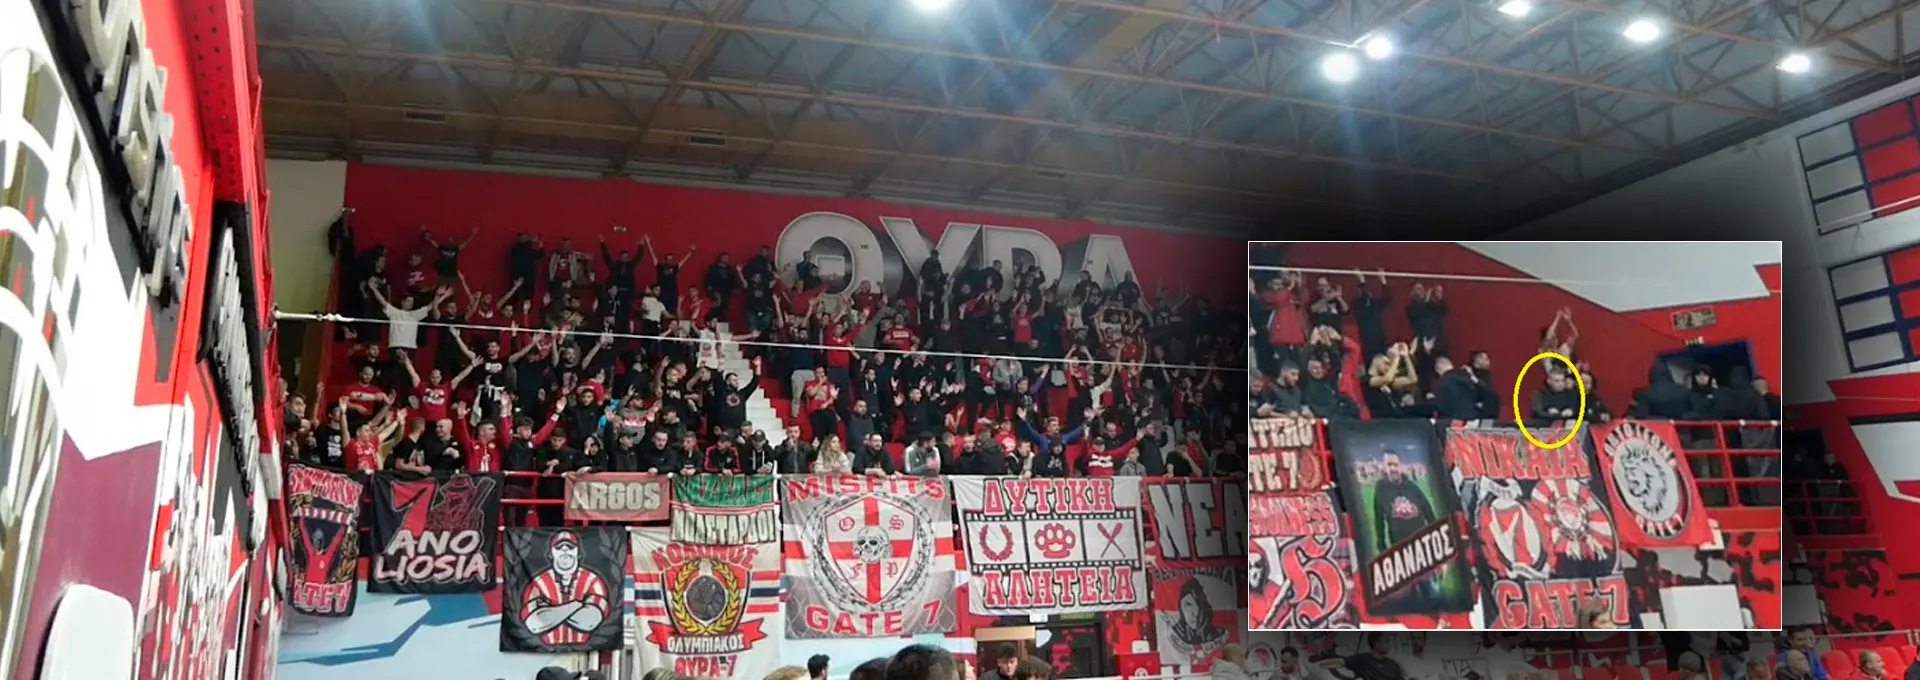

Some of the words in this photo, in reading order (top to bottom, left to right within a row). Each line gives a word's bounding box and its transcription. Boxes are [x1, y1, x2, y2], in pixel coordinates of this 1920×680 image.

[570, 480, 661, 511] ARGOS
[788, 473, 945, 500] MISFITS
[983, 477, 1115, 515] ΔΥΤΙΚΗ
[387, 529, 481, 559] ANO
[374, 553, 490, 583] LIOSIA
[1373, 525, 1454, 596] ΑΘΑΝΑΤΟΣ
[984, 567, 1137, 607] ΑΛΗΤΕΙΑ
[805, 605, 902, 635] GATE
[923, 600, 943, 625] 7
[667, 635, 745, 653] ΟΛΥΜΠΙΑΚΟΣ
